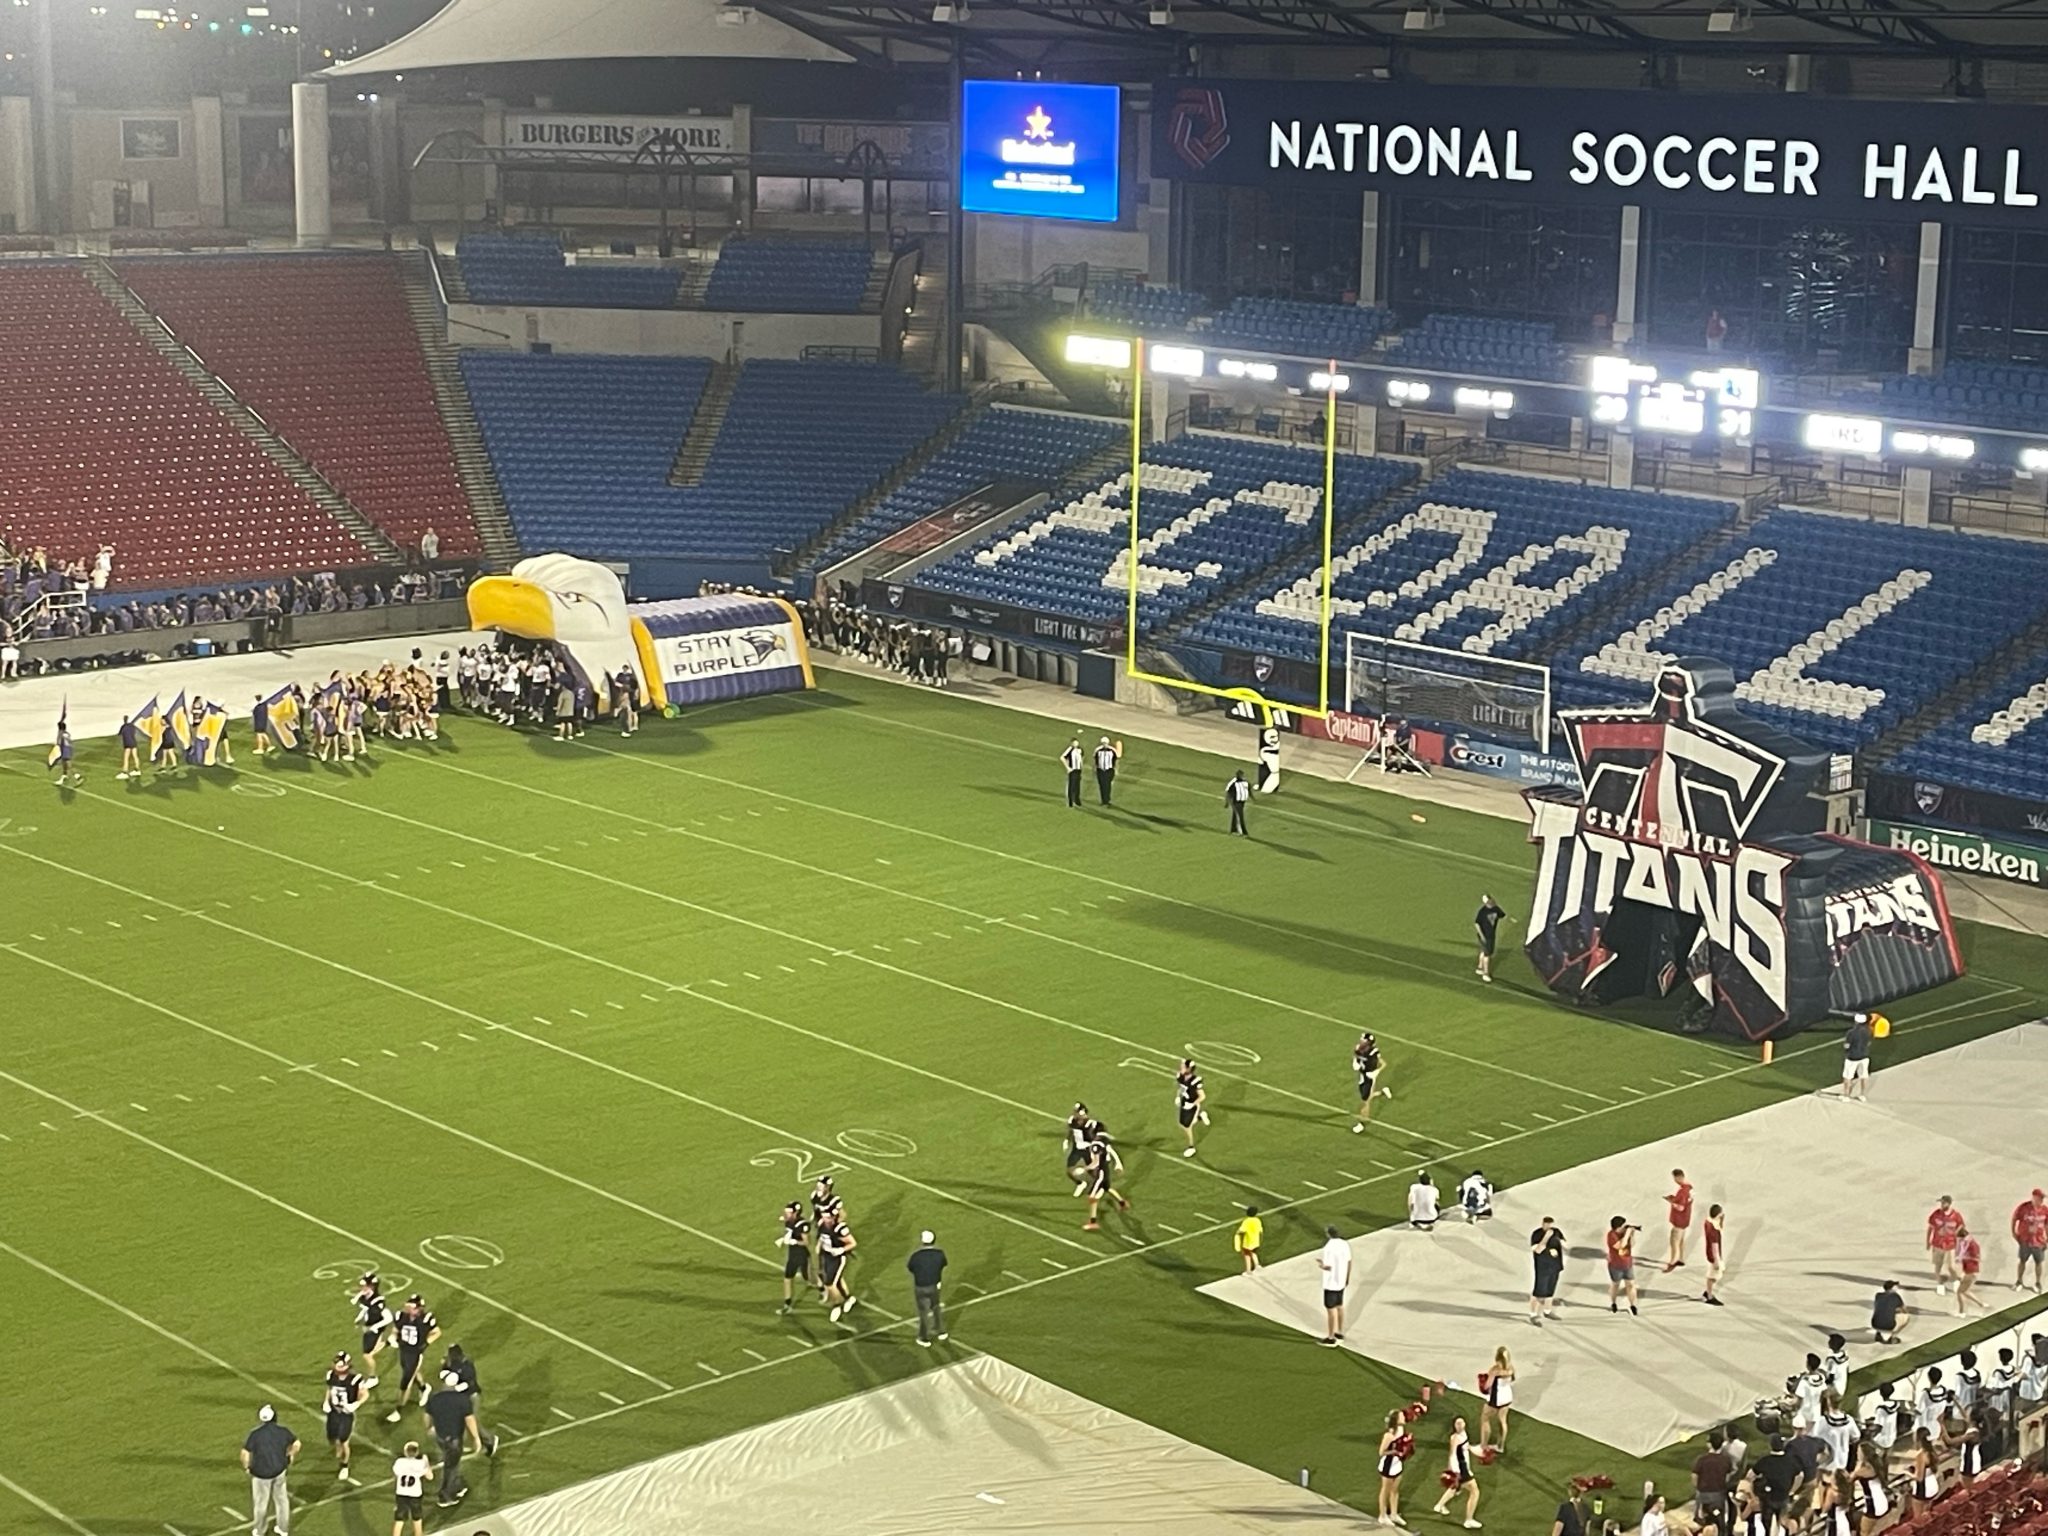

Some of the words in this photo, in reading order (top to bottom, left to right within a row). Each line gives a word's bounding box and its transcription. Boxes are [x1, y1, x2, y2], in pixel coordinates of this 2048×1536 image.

[521, 123, 635, 146] BURGERS
[652, 127, 721, 148] MORE
[1269, 120, 1533, 181] NATIONAL
[1569, 131, 1819, 196] SOCCER
[1863, 143, 2038, 206] HALL
[678, 635, 732, 653] STAY
[674, 654, 759, 677] PURPLE
[1472, 705, 1505, 725] LIGHT
[1325, 711, 1371, 747] Captain
[1450, 744, 1506, 768] Crest
[1520, 754, 1538, 767] THE
[1550, 760, 1577, 775] TOOT
[1520, 768, 1553, 784] BRAND
[1585, 806, 1730, 856] CENTENNIAL
[1889, 827, 2040, 883] Heineken
[1525, 797, 1793, 1013] TITANS
